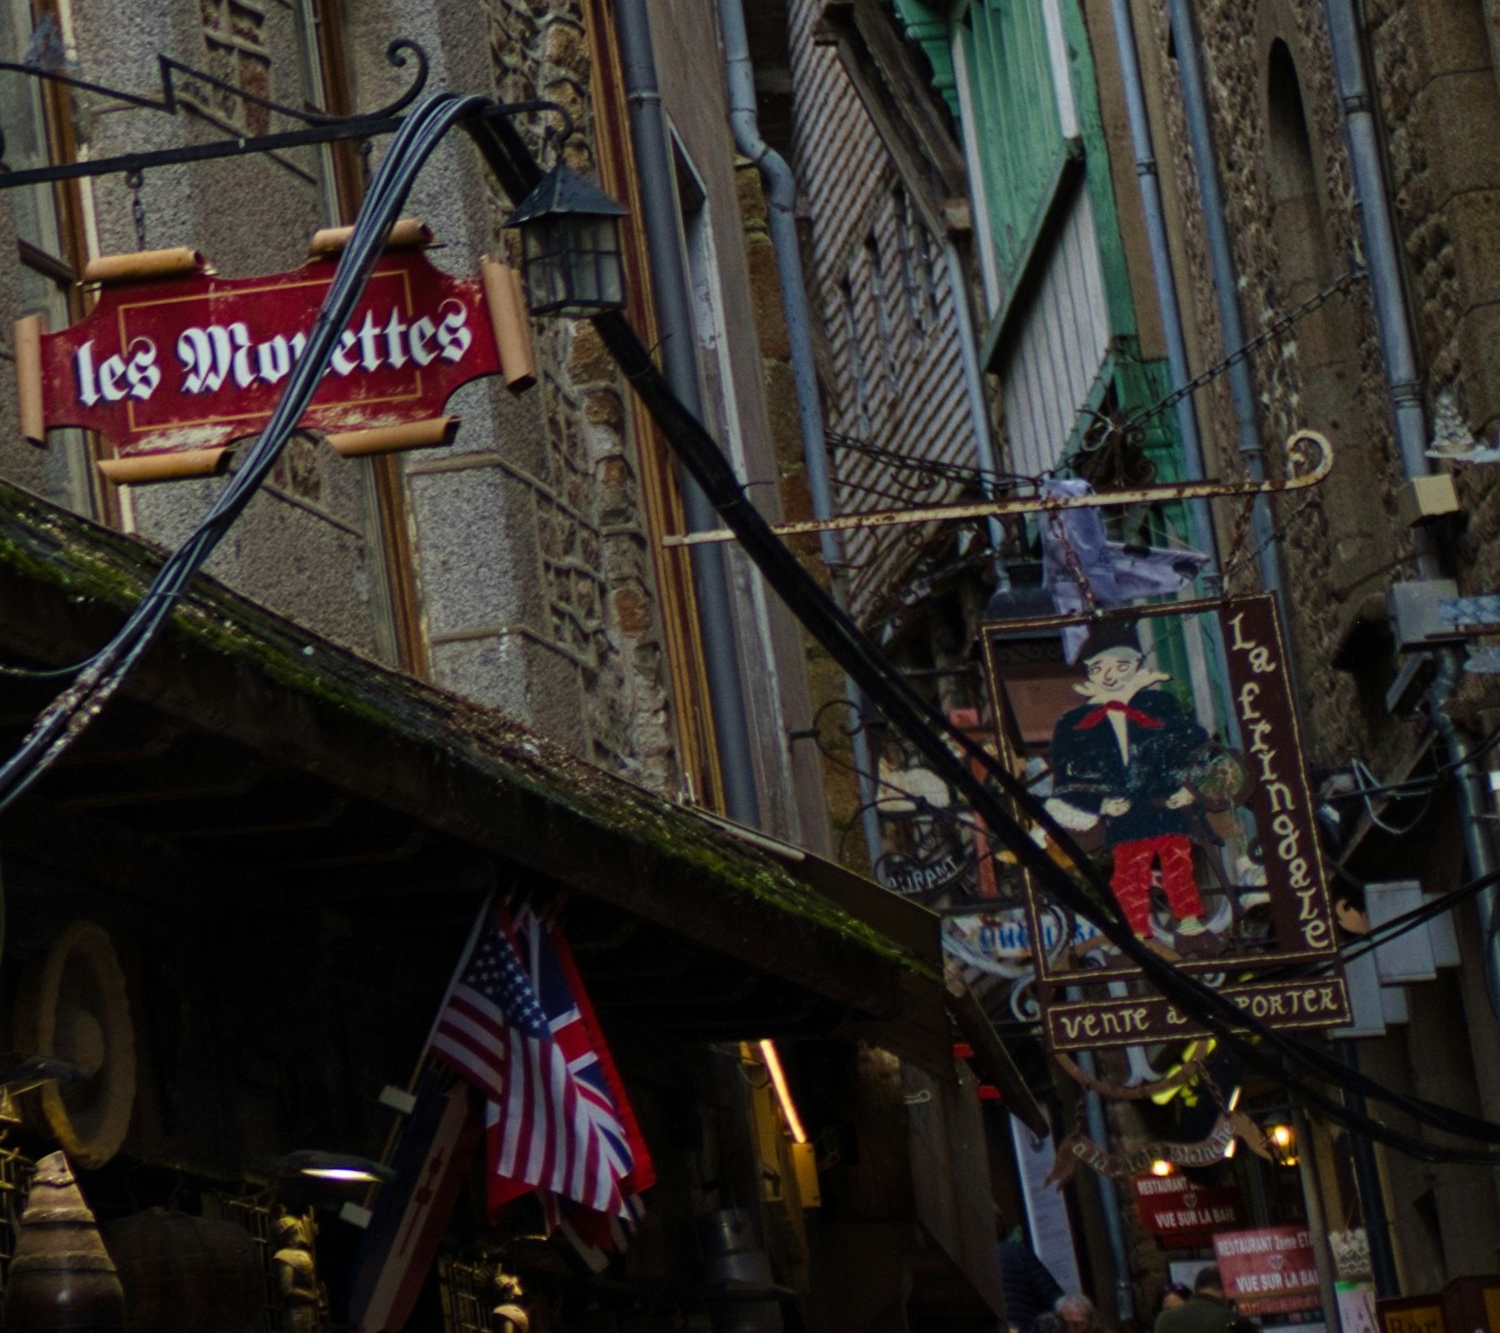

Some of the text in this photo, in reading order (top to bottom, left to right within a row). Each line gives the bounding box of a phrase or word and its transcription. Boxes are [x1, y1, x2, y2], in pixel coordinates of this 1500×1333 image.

[76, 336, 162, 408] les
[1136, 1177, 1188, 1196] RESTAURANT
[1154, 1211, 1177, 1229] VUE
[1177, 1209, 1198, 1227] SUR
[1198, 1208, 1212, 1225] LA
[1217, 1238, 1273, 1256] RESTAURANT
[1236, 1275, 1259, 1293] VUE
[1260, 1273, 1283, 1291] SUR
[1283, 1271, 1299, 1288] LA
